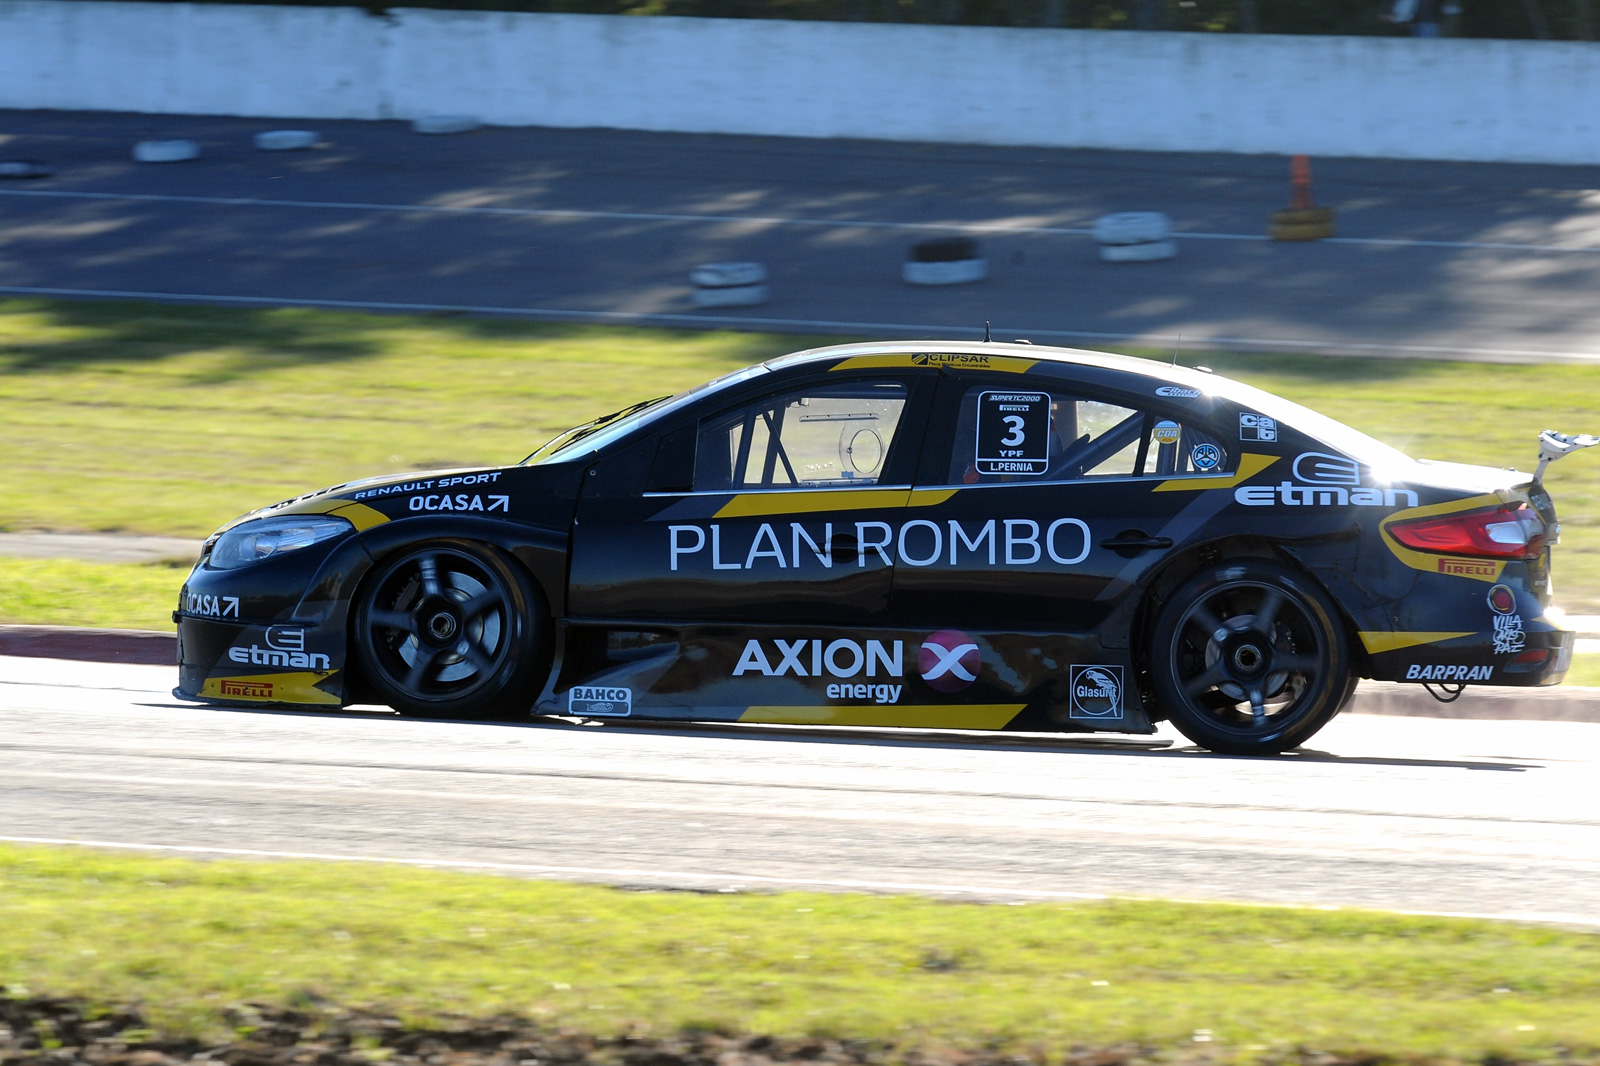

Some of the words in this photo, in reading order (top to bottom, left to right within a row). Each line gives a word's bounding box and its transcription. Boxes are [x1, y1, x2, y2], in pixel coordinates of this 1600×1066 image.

[929, 354, 989, 363] CLIPSAR
[999, 404, 1030, 412] PIRELLI
[1000, 415, 1026, 447] 3
[999, 450, 1024, 458] YPF
[990, 462, 1033, 472] L.PERNIA
[354, 480, 435, 500] RENAULT
[437, 472, 502, 488] SPORT
[1234, 481, 1419, 507] etman
[409, 494, 484, 512] OCASA
[668, 522, 833, 571] PLAN
[854, 518, 1092, 567] ROMBO
[1438, 558, 1496, 577] PIRELLI
[186, 593, 221, 617] OCASA
[1492, 614, 1524, 630] VILLA
[1492, 640, 1526, 655] PAZ
[228, 644, 331, 670] etman
[732, 638, 903, 678] AXION
[1405, 664, 1494, 681] BARPRAN
[221, 680, 274, 698] PIRELLI
[573, 688, 628, 701] BAHCO
[826, 681, 902, 704] energy
[1076, 685, 1118, 698] Glasurt
